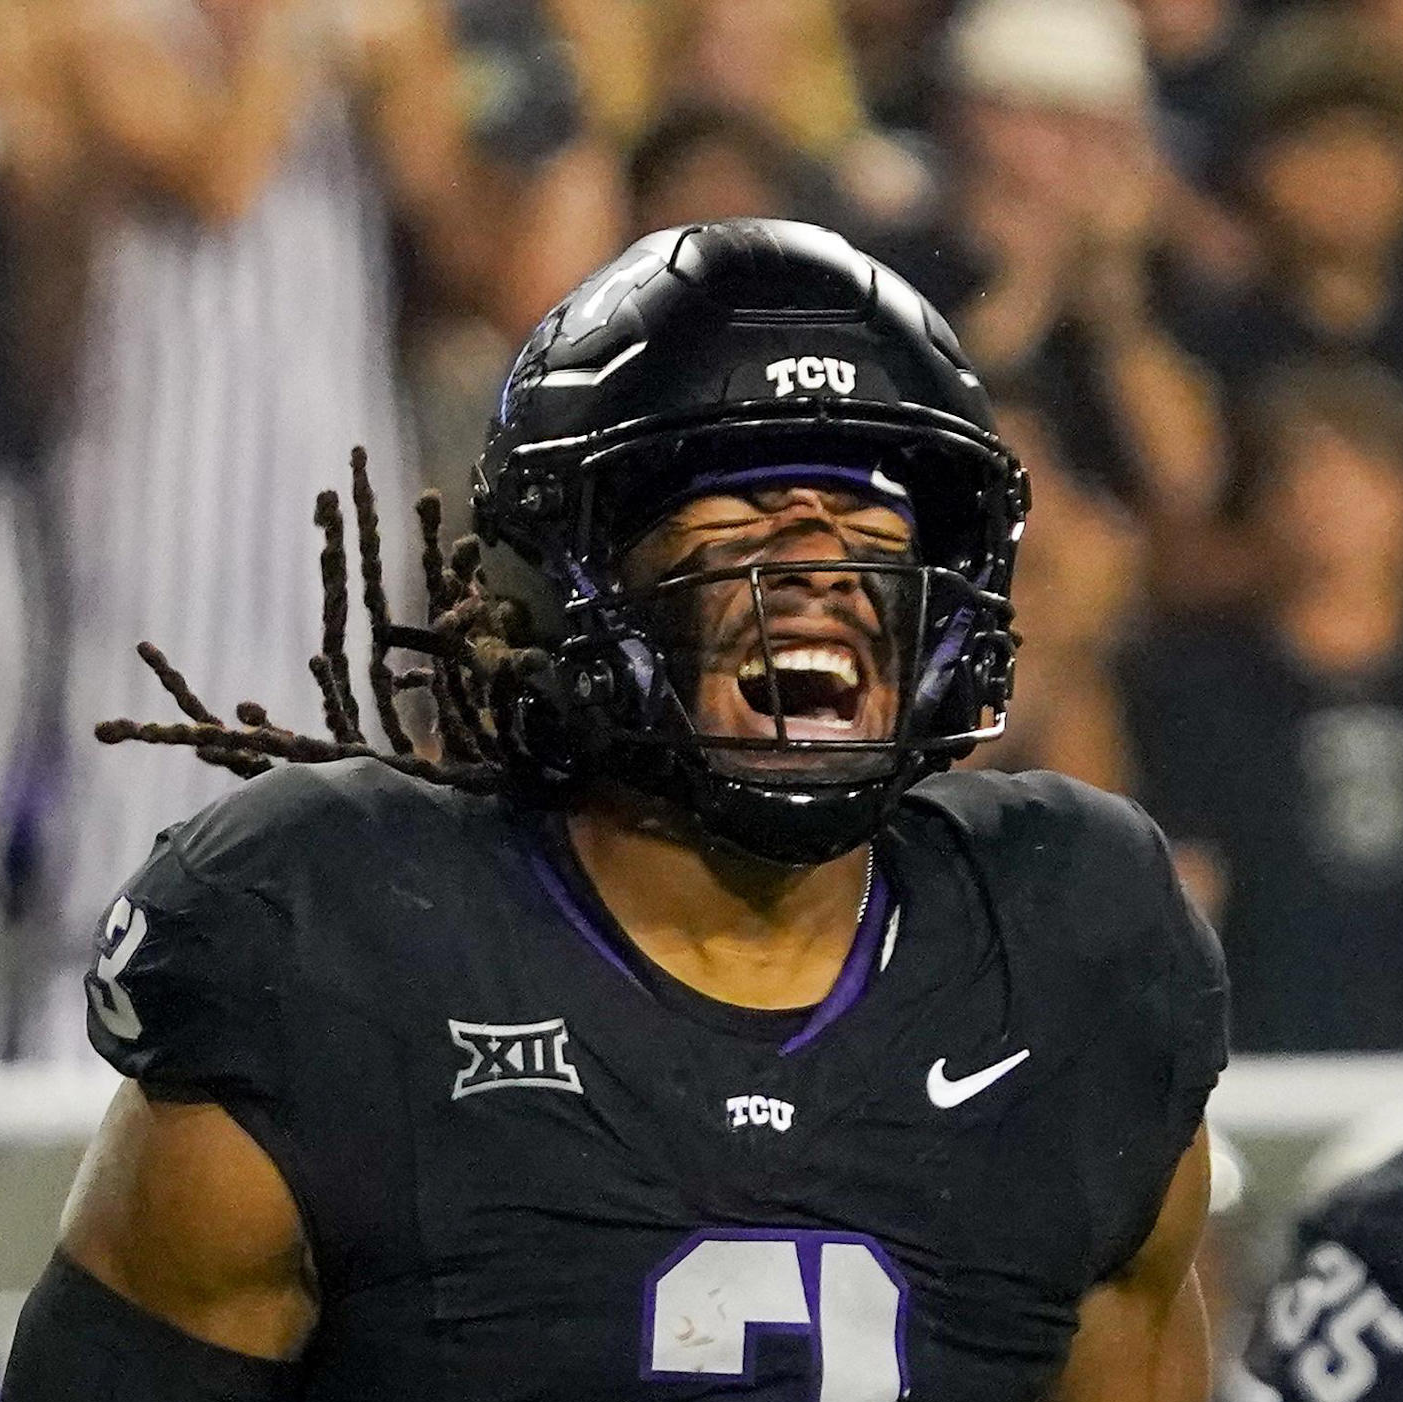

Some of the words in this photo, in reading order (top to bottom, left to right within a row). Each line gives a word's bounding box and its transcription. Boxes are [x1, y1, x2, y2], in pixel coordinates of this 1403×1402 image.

[766, 355, 856, 398] TCU
[88, 893, 149, 1041] 3
[456, 1024, 572, 1090] XII
[725, 1093, 796, 1132] TCU
